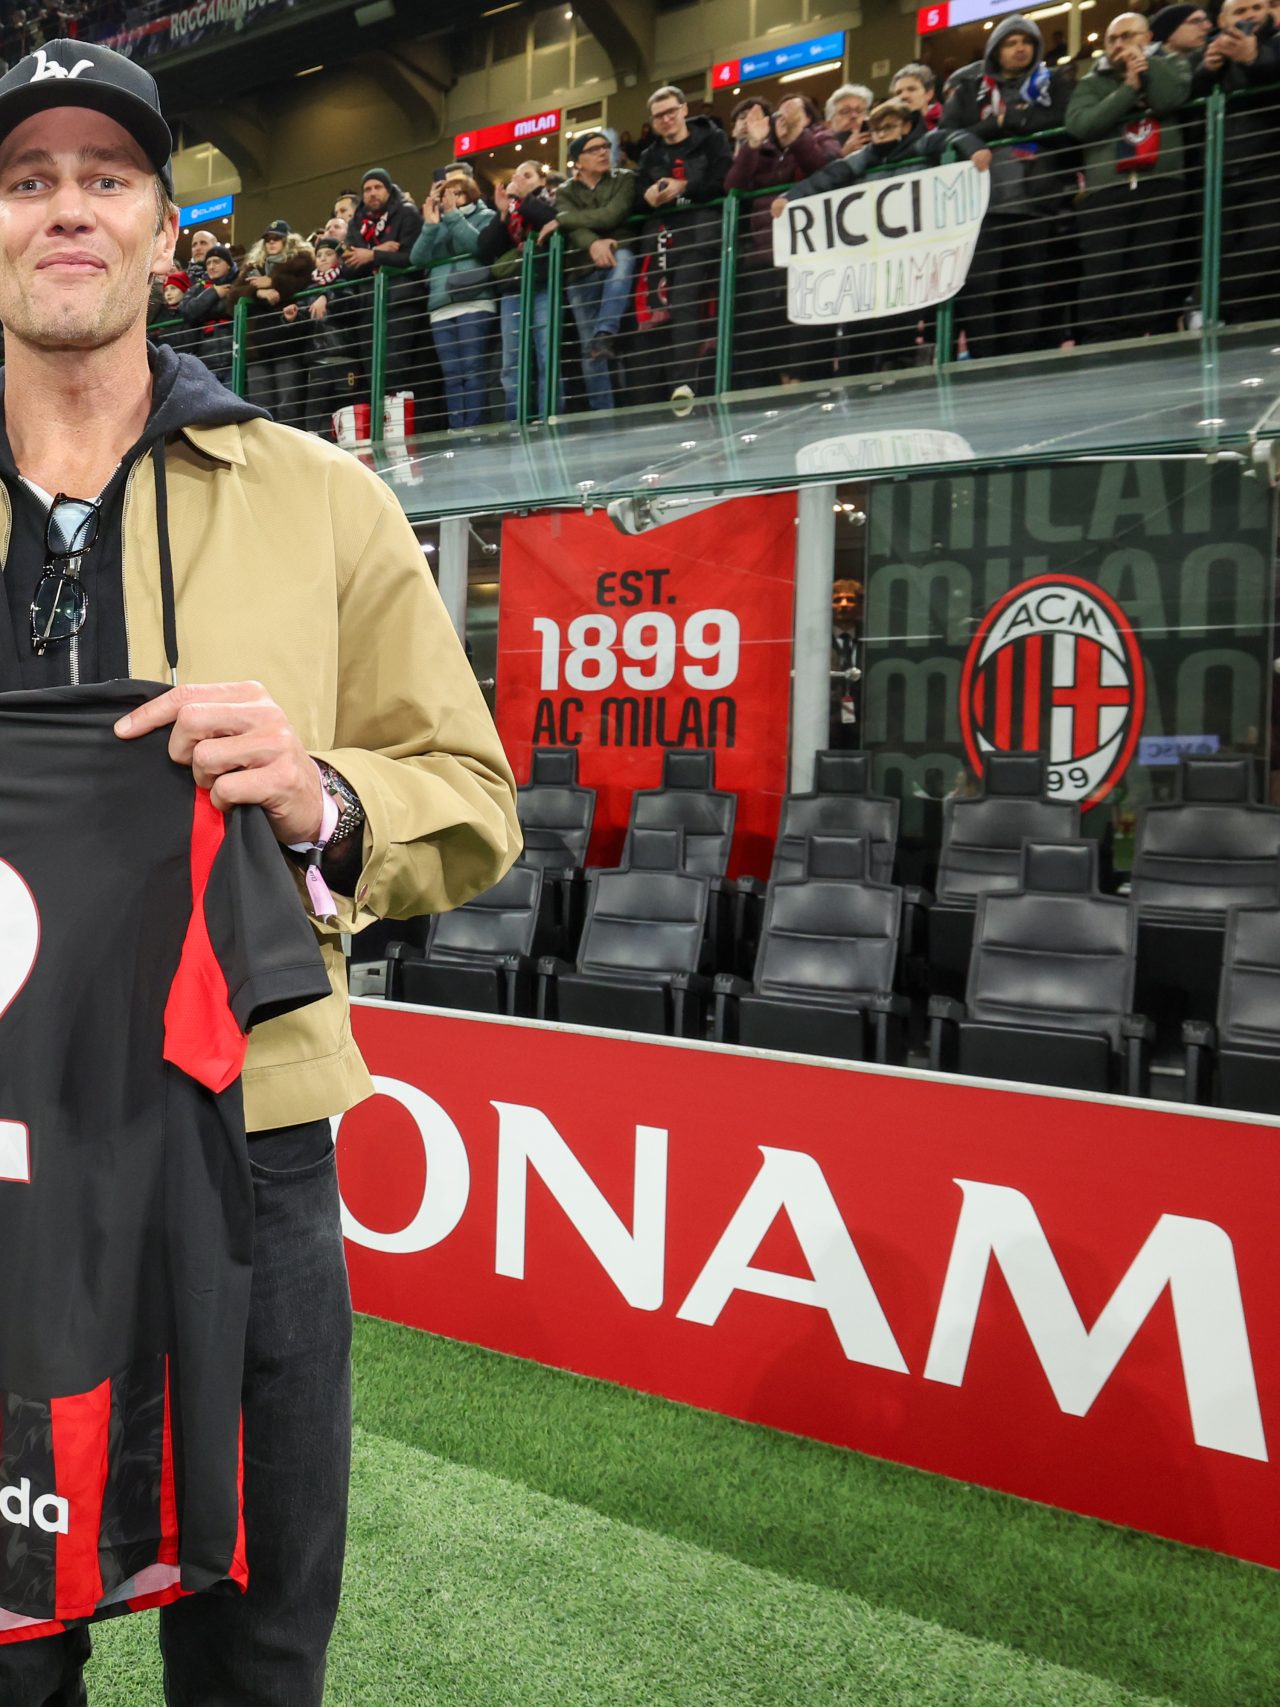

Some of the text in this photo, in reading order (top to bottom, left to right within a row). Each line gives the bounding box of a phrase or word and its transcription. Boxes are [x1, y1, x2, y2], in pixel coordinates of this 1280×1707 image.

[927, 9, 939, 26] 5
[720, 66, 731, 81] 4
[461, 113, 556, 151] 3 MILAN
[788, 168, 981, 255] RICCI MI
[596, 568, 677, 607] EST.
[1000, 593, 1104, 641] ACM
[532, 608, 741, 692] 1899
[531, 695, 738, 748] AC MILAN
[337, 1074, 1270, 1463] ONAM
